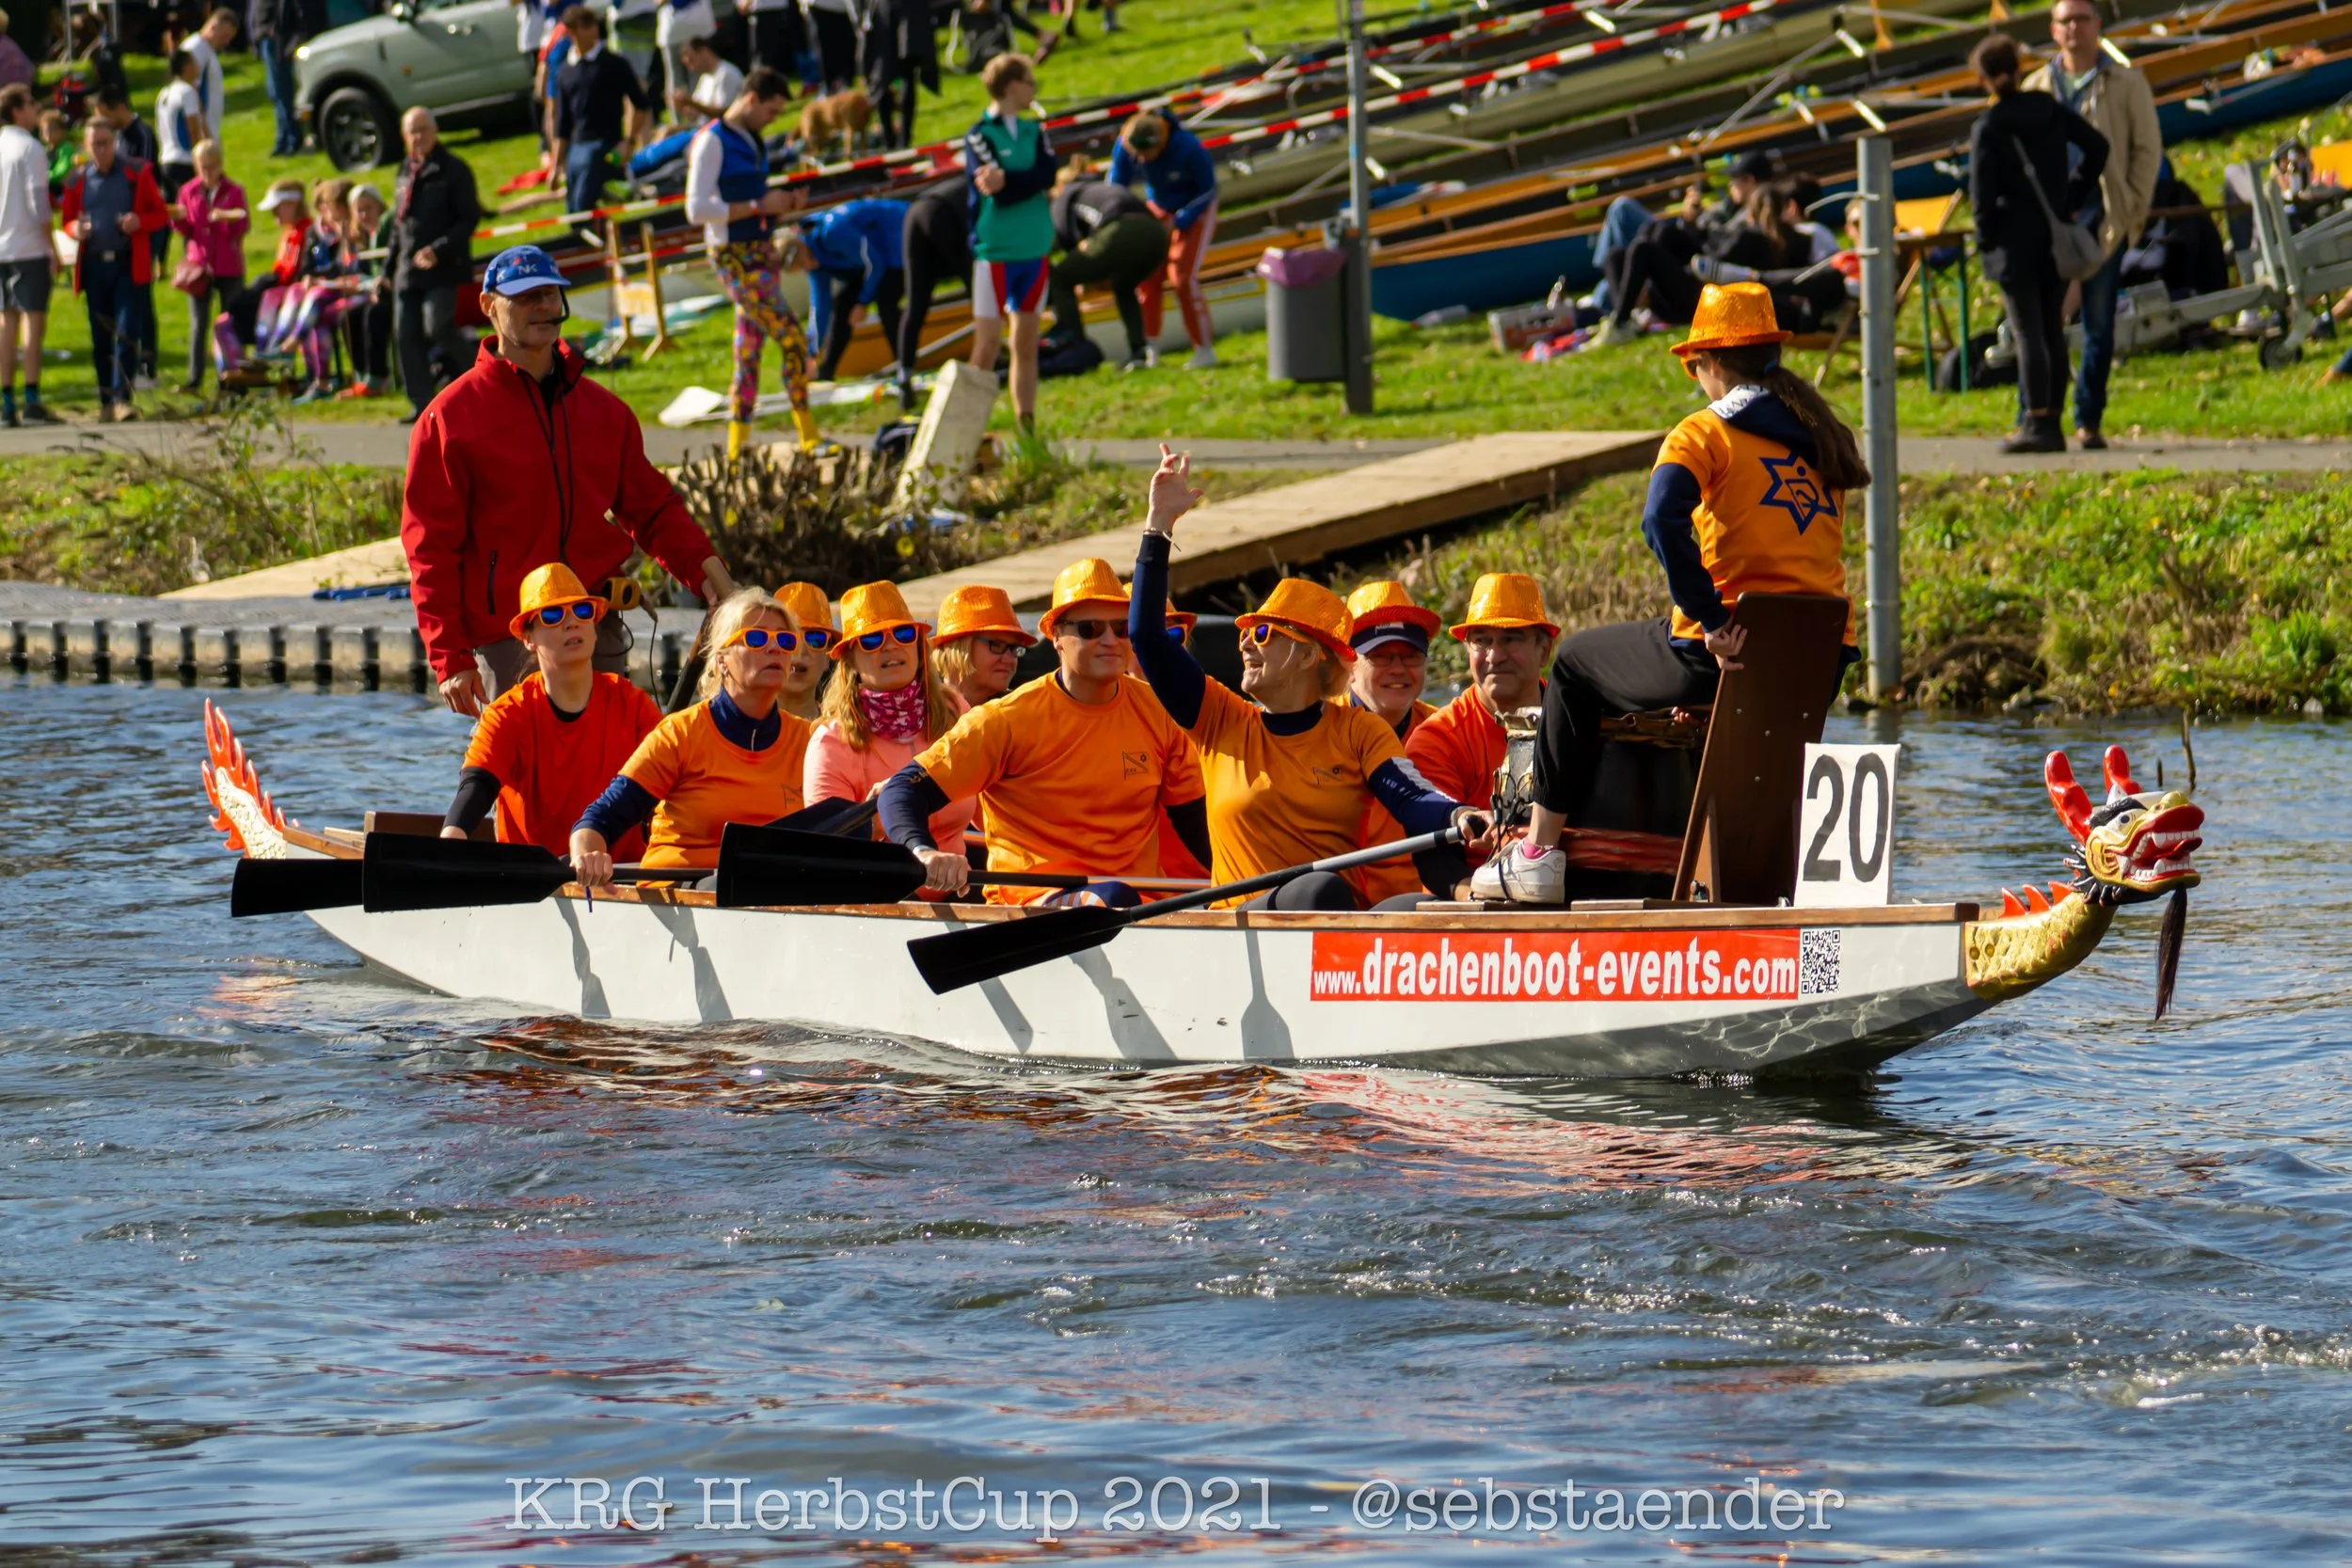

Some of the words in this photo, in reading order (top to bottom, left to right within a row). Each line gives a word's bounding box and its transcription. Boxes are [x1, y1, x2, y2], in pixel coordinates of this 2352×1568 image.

[518, 263, 538, 276] NK
[1803, 752, 1889, 882] 20
[1314, 935, 1796, 996] www.drachenboot-events.com
